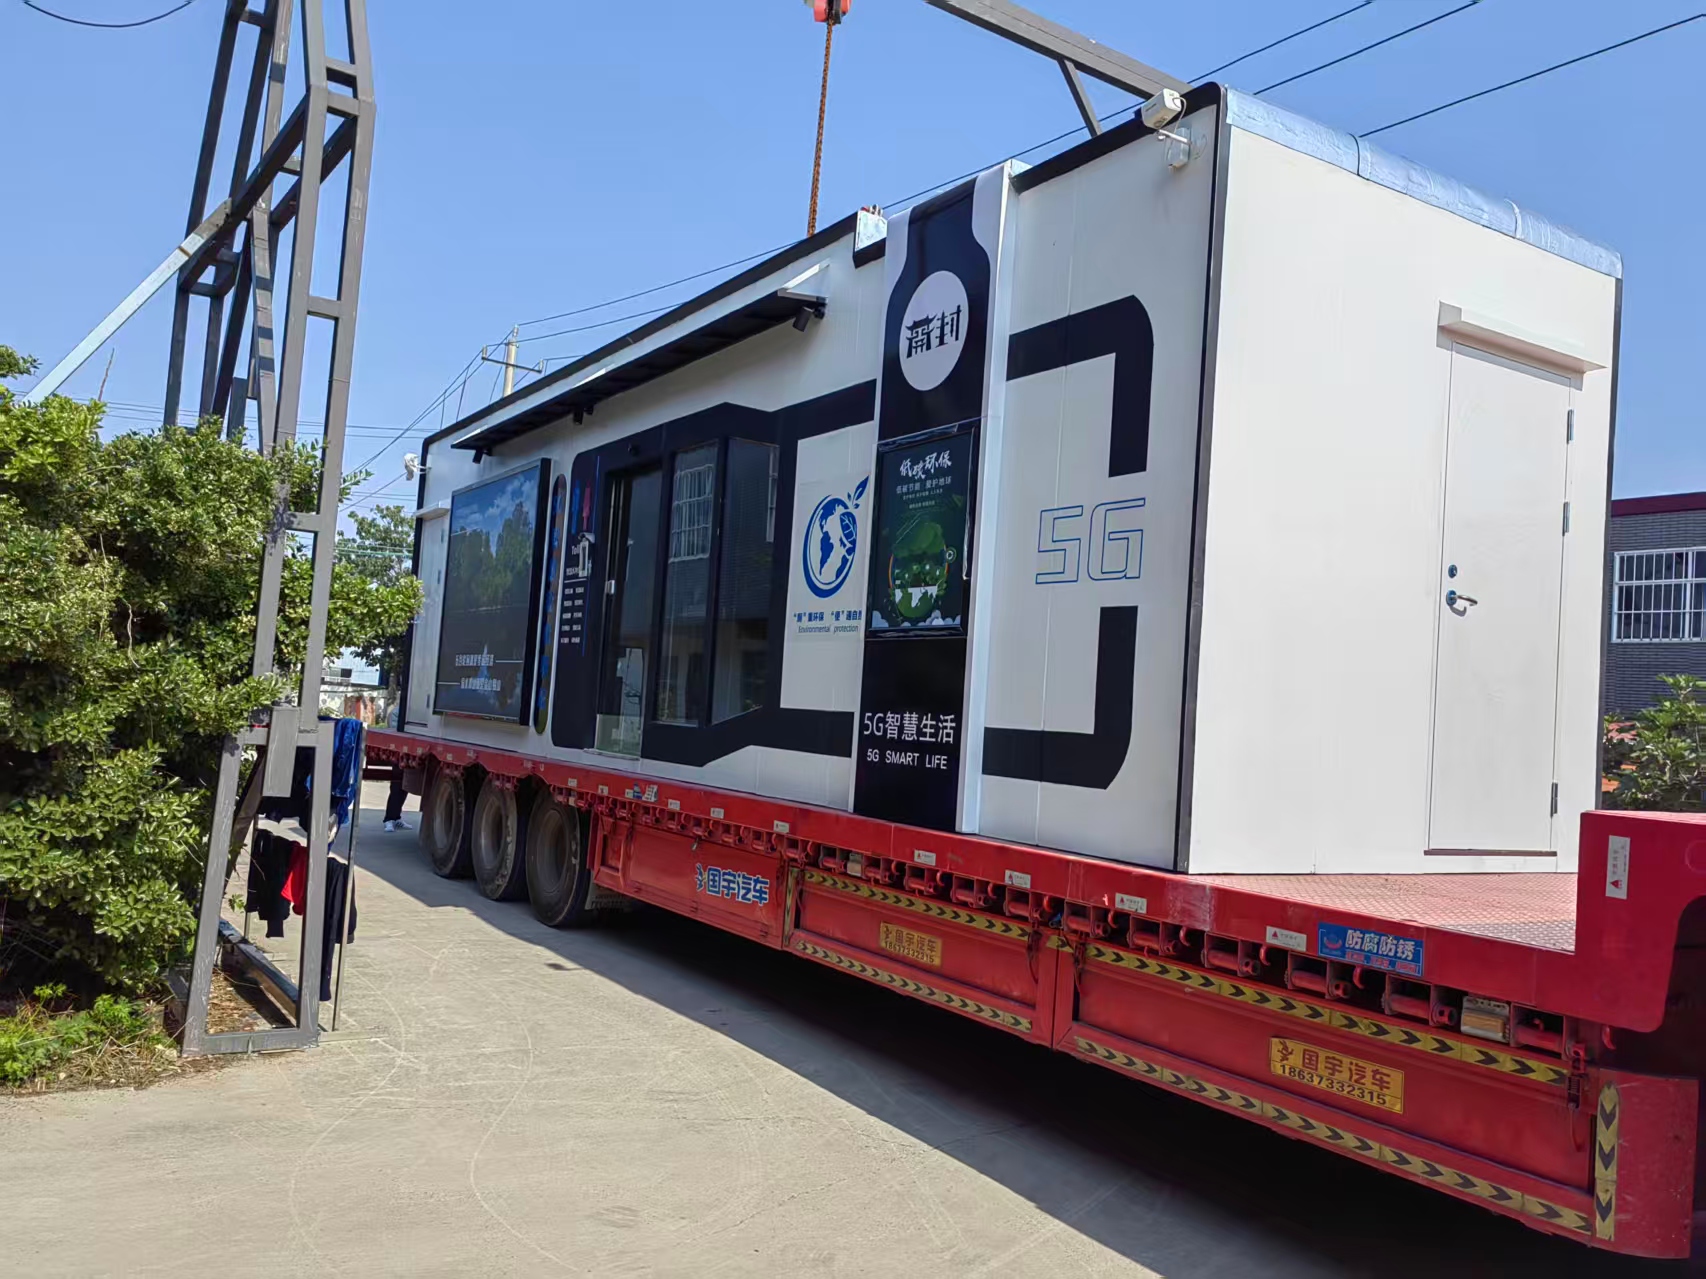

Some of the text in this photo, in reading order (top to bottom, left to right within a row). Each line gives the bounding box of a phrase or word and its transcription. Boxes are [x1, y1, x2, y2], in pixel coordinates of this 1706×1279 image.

[1035, 497, 1146, 585] 5G
[798, 624, 859, 635] Environmental protection
[863, 710, 956, 744] 5G智慧生活
[866, 749, 948, 769] 5G SMART LIFE
[706, 865, 769, 906] 国宇汽车
[1345, 929, 1415, 960] 防腐防锈
[1280, 1064, 1387, 1106] 18637332315
[1302, 1048, 1391, 1092] 国宇汽车
